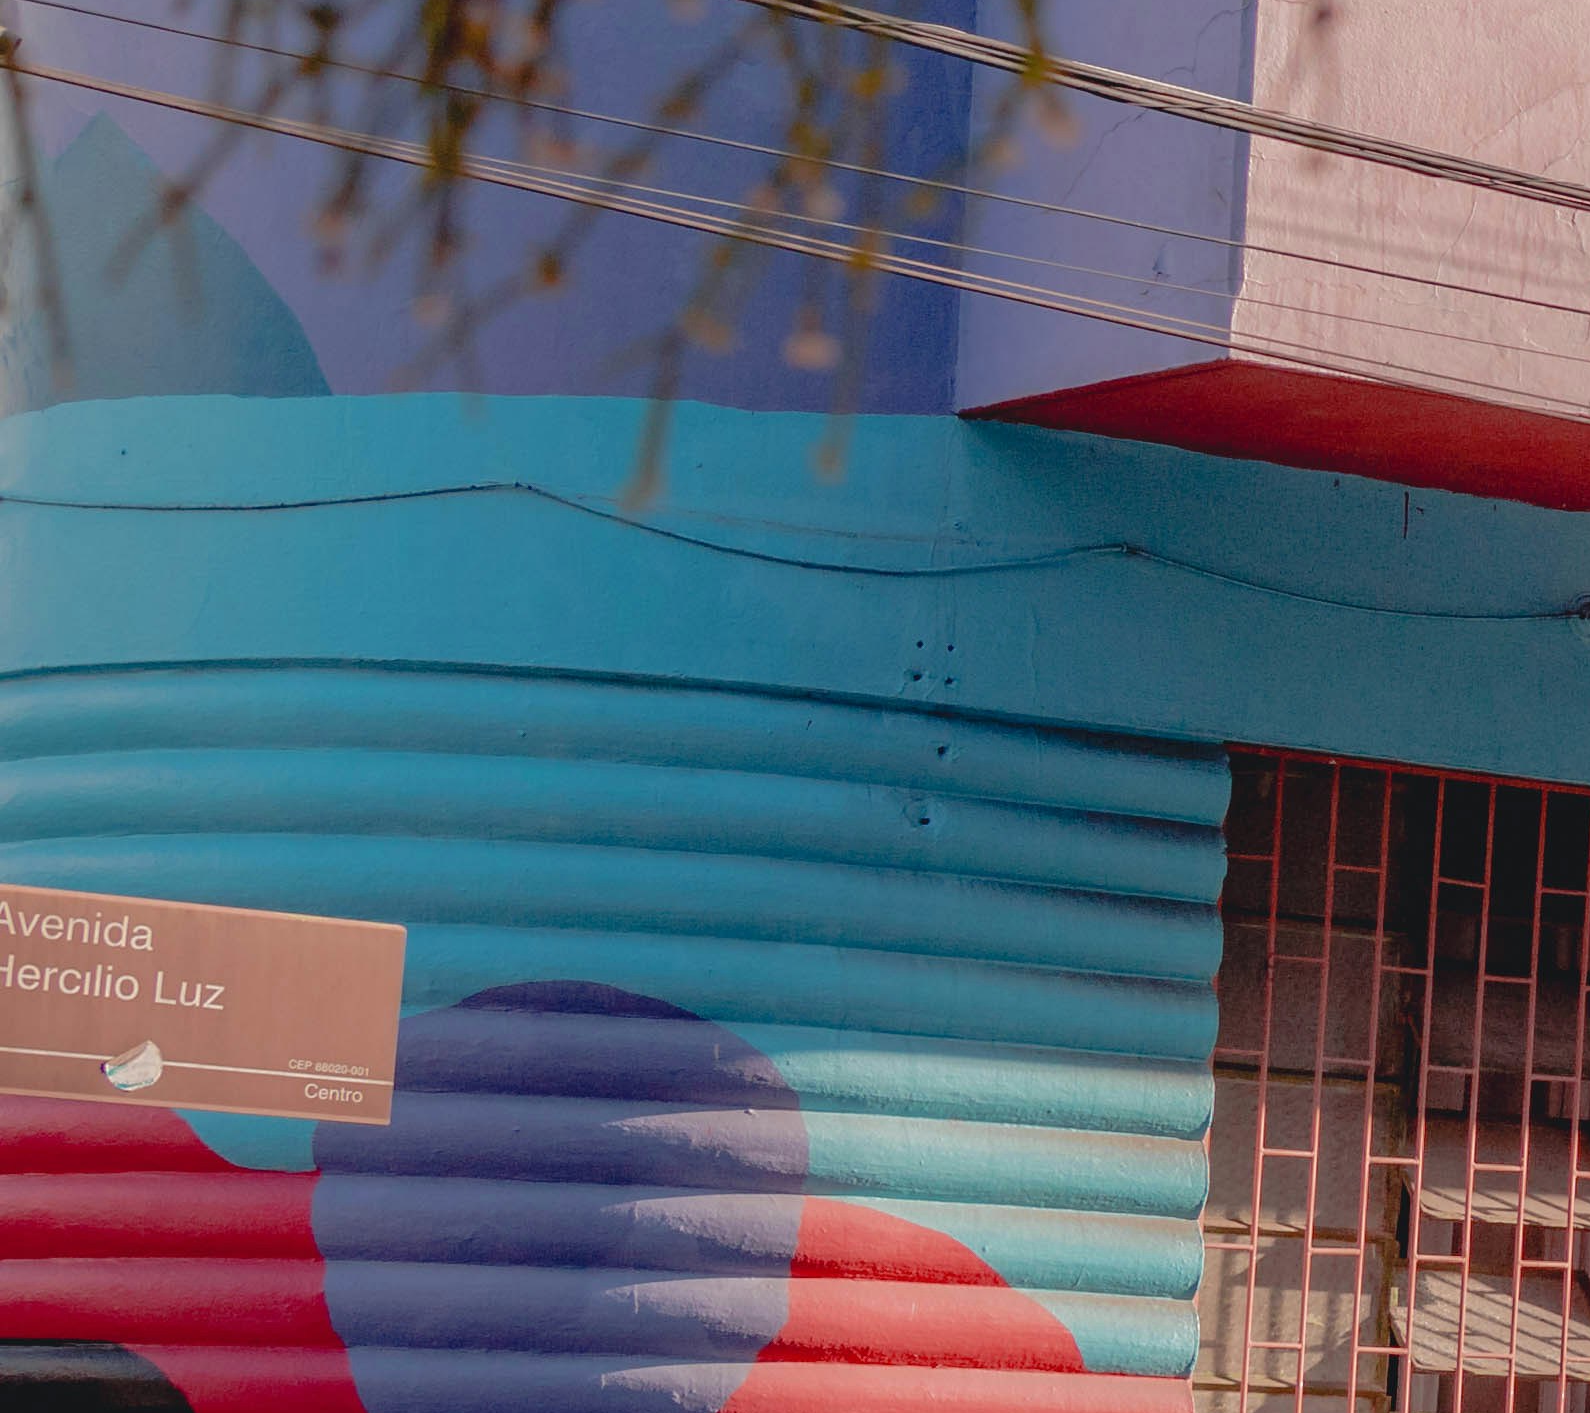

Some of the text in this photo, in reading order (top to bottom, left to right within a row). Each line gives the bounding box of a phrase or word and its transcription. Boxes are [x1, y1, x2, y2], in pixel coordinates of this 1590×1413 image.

[0, 900, 153, 951] Avenida
[155, 970, 225, 1010] Luz
[288, 1058, 312, 1070] CEP
[304, 1083, 363, 1103] Centro
